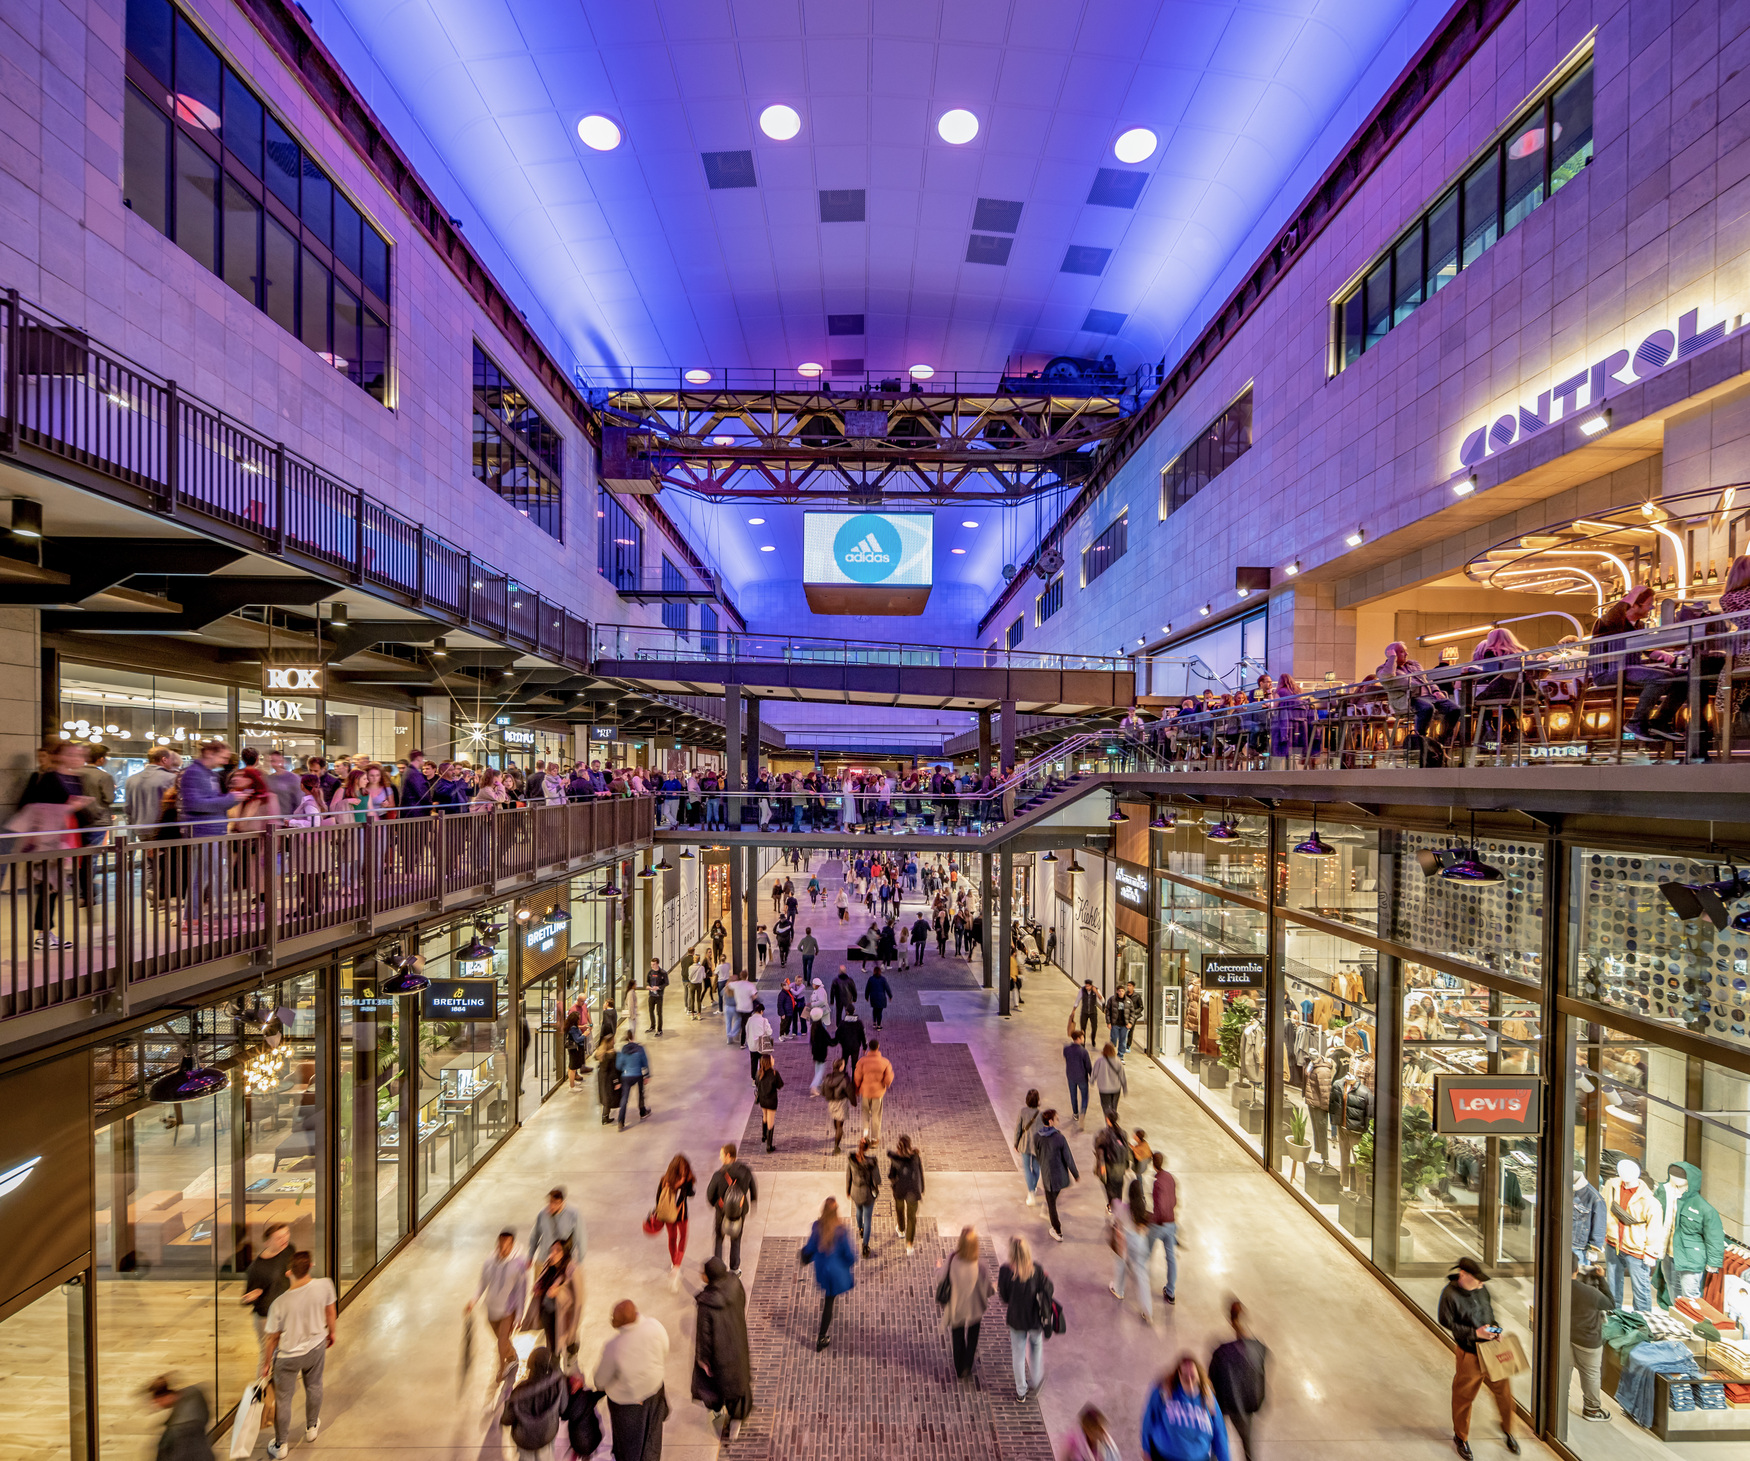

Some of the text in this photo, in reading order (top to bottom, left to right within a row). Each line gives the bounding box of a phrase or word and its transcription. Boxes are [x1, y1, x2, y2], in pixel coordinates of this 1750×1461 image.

[1460, 307, 1726, 467] CONTROL
[845, 552, 890, 563] adidas
[267, 668, 320, 689] ROX
[262, 698, 304, 722] ROX
[1075, 896, 1102, 931] Kiehl's
[526, 921, 567, 947] BREITLING
[1206, 962, 1263, 973] Abercrombie
[1217, 973, 1251, 983] & Fitch
[433, 998, 485, 1006] BREITLING
